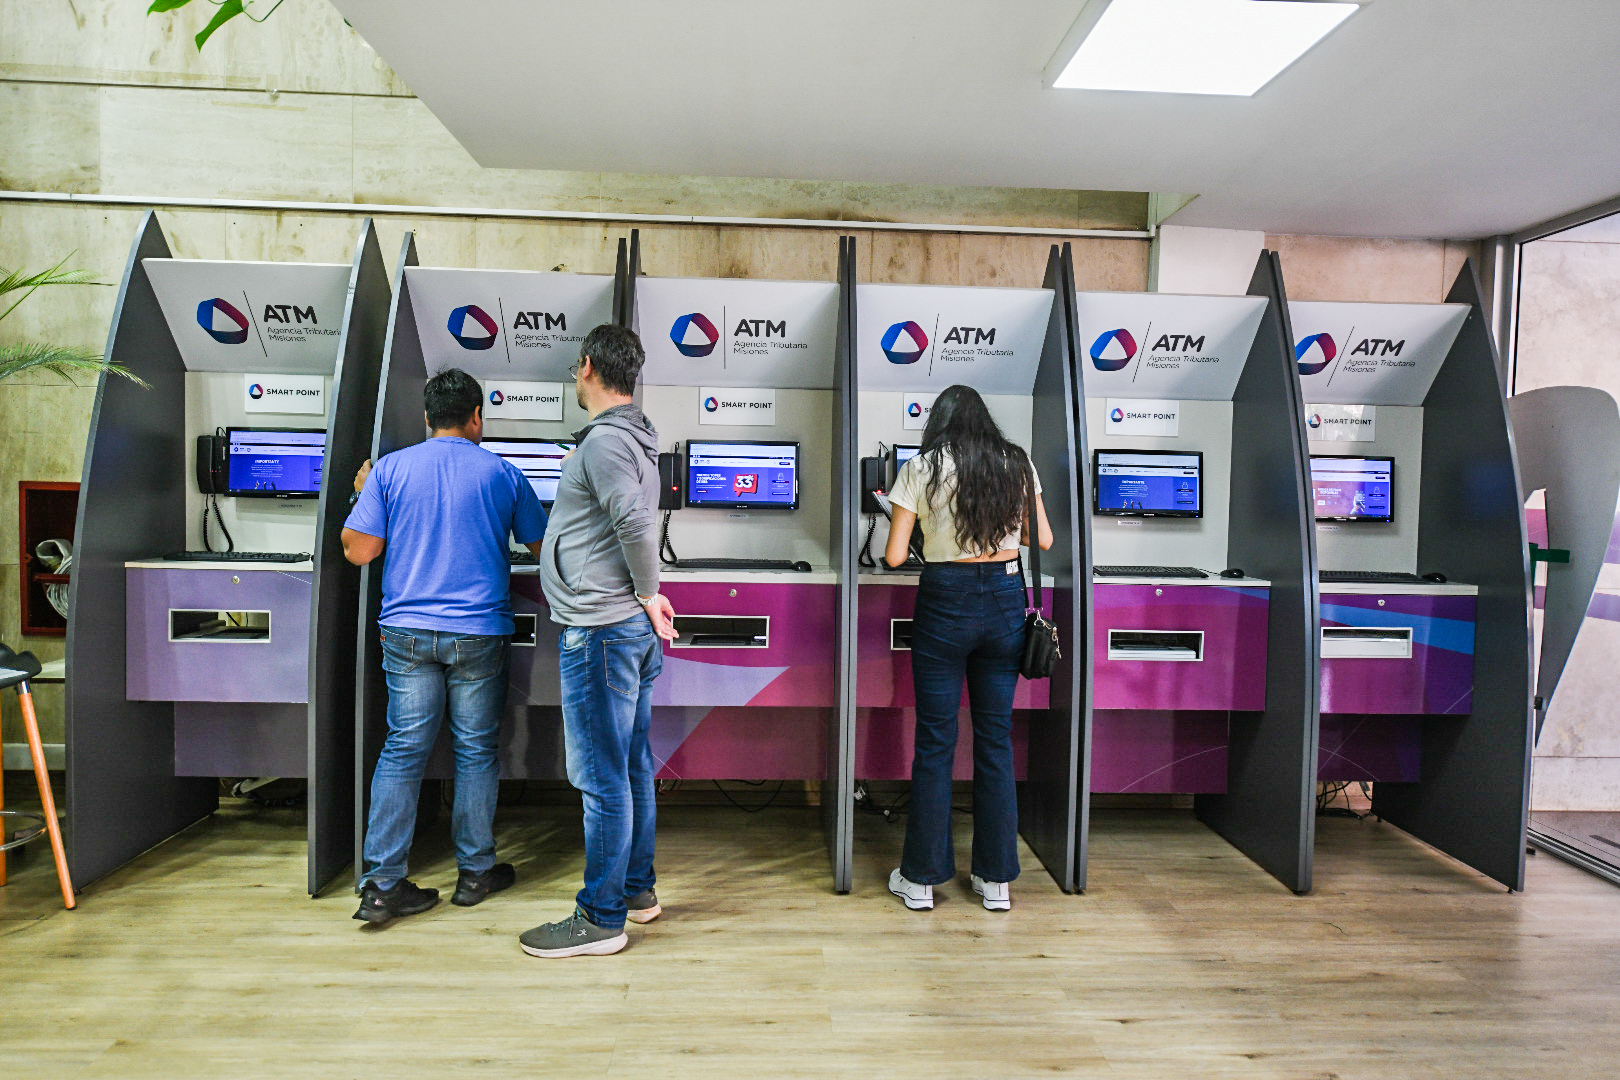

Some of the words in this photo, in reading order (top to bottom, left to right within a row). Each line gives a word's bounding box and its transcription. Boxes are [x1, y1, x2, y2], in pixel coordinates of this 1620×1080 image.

[264, 304, 318, 325] ATM
[513, 311, 567, 332] ATM
[267, 326, 303, 335] Agencia
[734, 318, 787, 338] ATM
[268, 334, 307, 342] Misiones
[514, 333, 550, 342] Agencia
[551, 334, 586, 342] Tributari
[943, 326, 997, 346] ATM
[515, 340, 552, 349] Misiones
[733, 340, 768, 349] Agencia
[770, 341, 808, 349] Tributaria
[1151, 334, 1206, 352] ATM
[1350, 338, 1406, 357] ATM
[733, 347, 769, 355] Misiones
[941, 347, 975, 356] Agencia
[976, 348, 1014, 357] Tributaria
[1148, 354, 1181, 363] Agencia
[1183, 355, 1220, 363] Tributaria
[1146, 361, 1180, 369] Misiones
[1345, 359, 1378, 367] Agencia
[1380, 359, 1416, 368] Tributaria
[1342, 365, 1377, 373] Misiones
[266, 388, 294, 396] SMART
